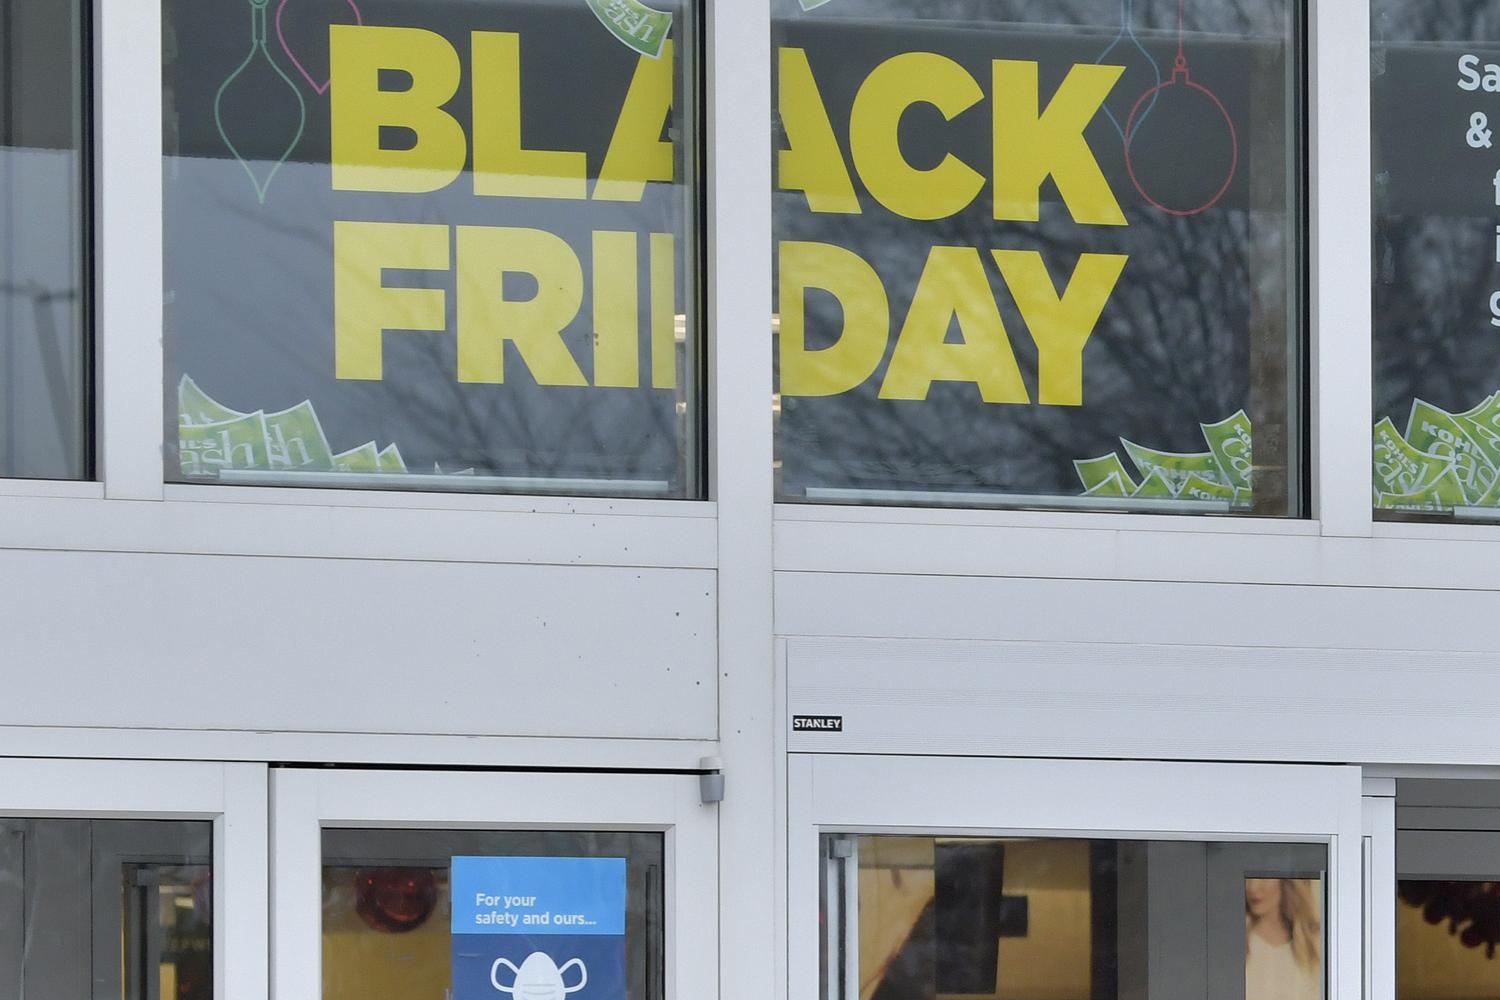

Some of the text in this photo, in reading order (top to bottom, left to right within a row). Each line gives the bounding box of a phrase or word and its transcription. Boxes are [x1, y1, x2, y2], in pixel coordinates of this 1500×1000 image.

[1466, 112, 1492, 148] &
[794, 719, 841, 728] STANLEY
[476, 894, 536, 909] For your
[475, 912, 597, 927] safety and ours...
